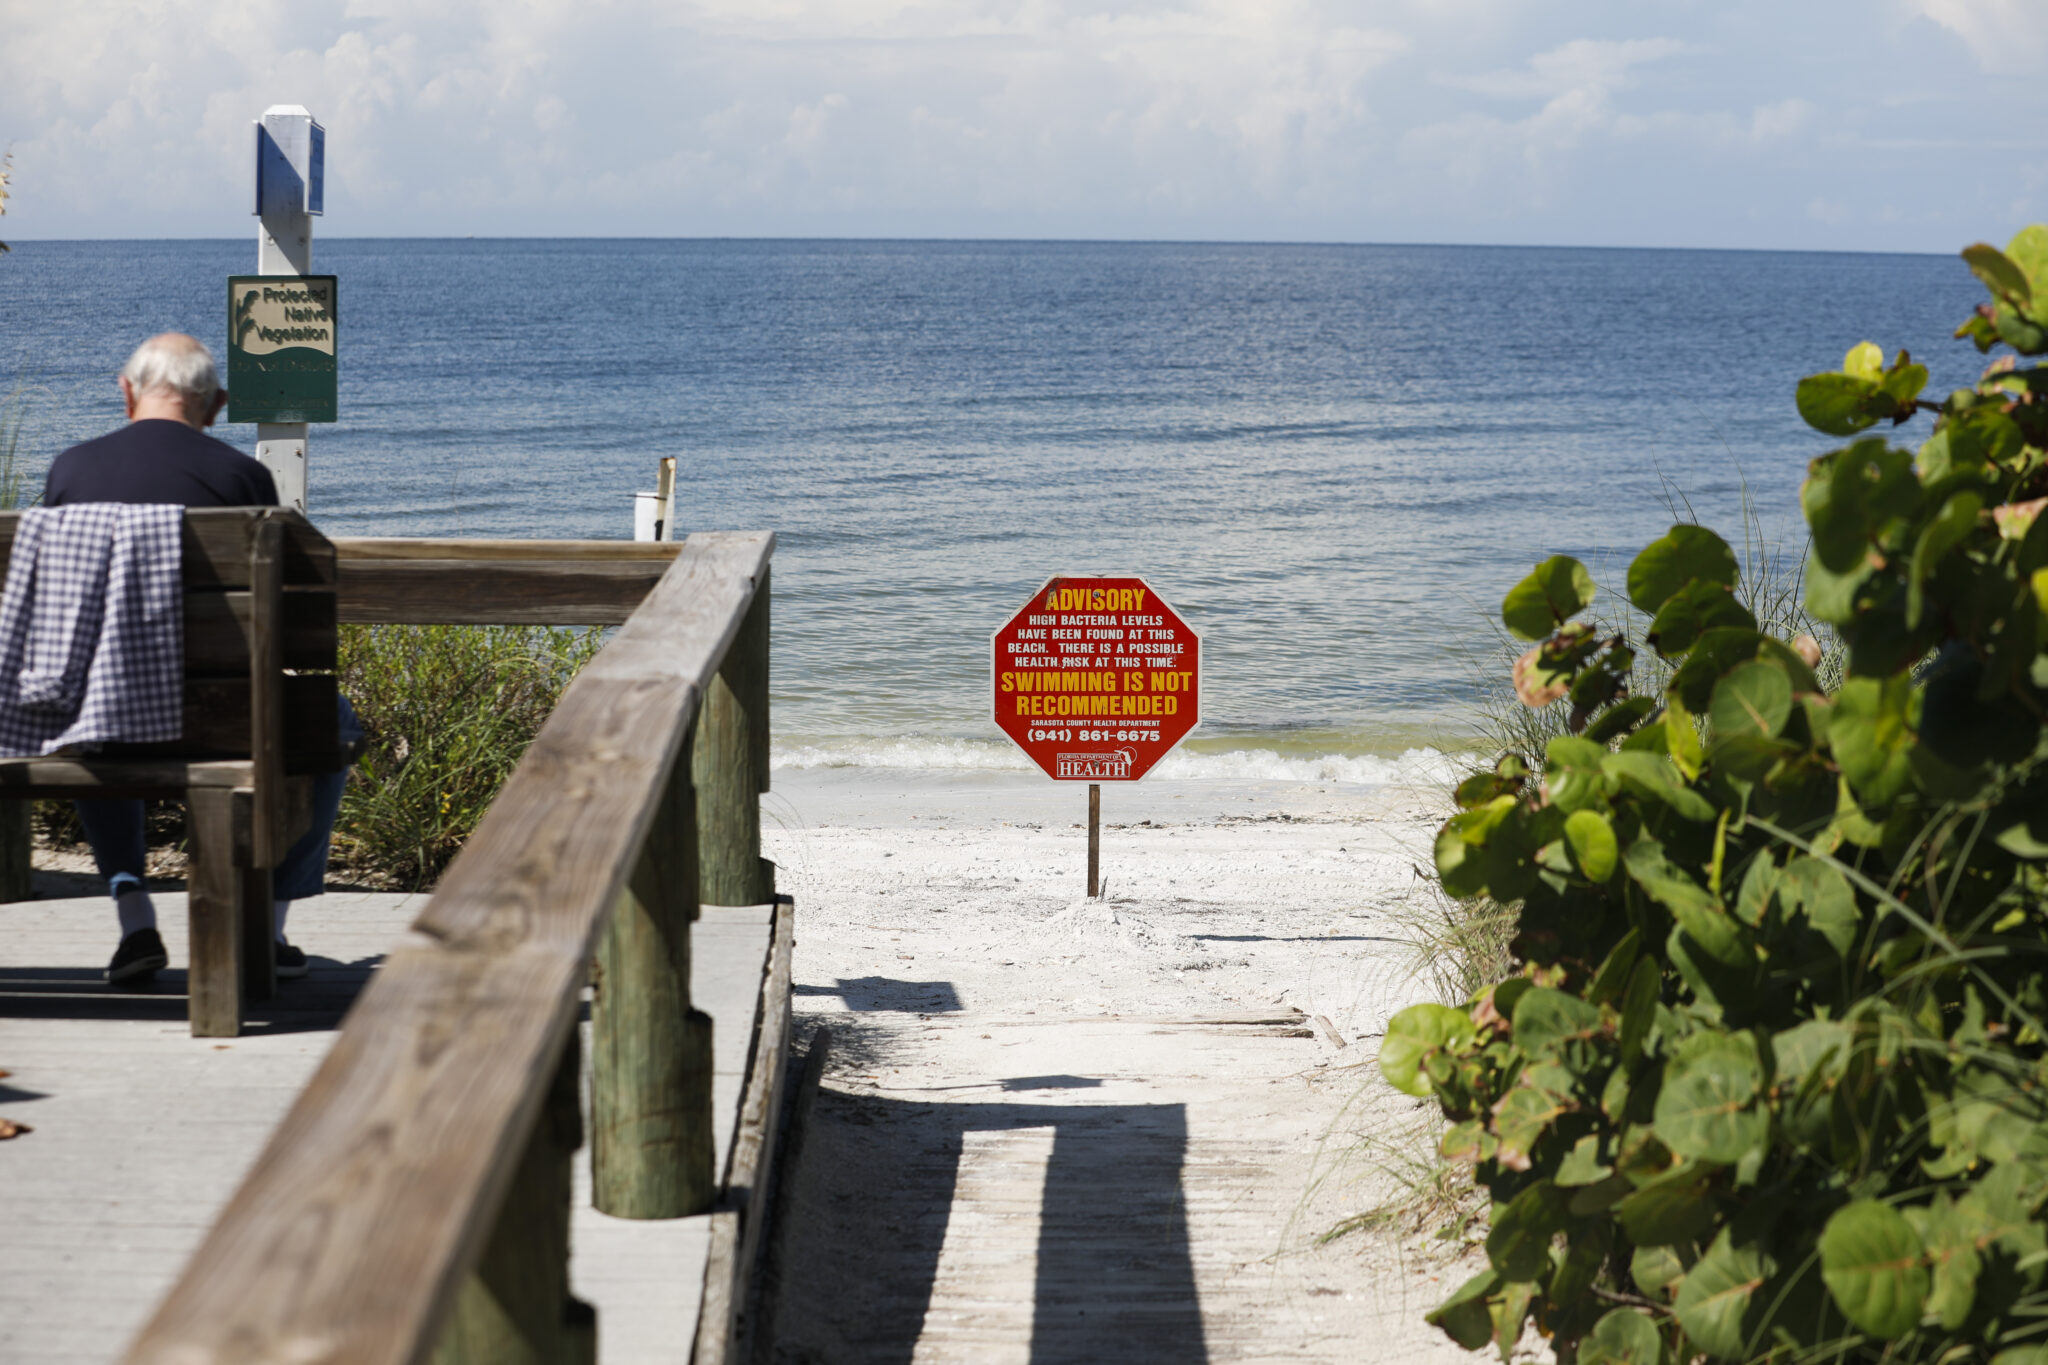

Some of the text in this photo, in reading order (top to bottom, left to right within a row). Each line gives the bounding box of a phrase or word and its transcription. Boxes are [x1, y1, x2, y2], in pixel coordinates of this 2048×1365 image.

[264, 287, 327, 304] Protected
[285, 306, 328, 322] Native
[259, 325, 328, 345] Vegetation
[1045, 588, 1145, 611] ADVISORY
[1029, 615, 1163, 626] HIGH BACTERIA LEVELS
[1018, 629, 1174, 640] HAVE BEEN FOUND AT THIS
[1008, 643, 1184, 654] BEACH. THERE IS A POSSIBLE
[1015, 657, 1176, 668] HEALTH RISK AT THIS TIME.
[1001, 672, 1192, 692] SWIMMING IS NOT
[1017, 696, 1178, 716] RECOMMENDED
[1028, 729, 1160, 742] (941) 861-6675
[1060, 762, 1126, 776] HEALTH
